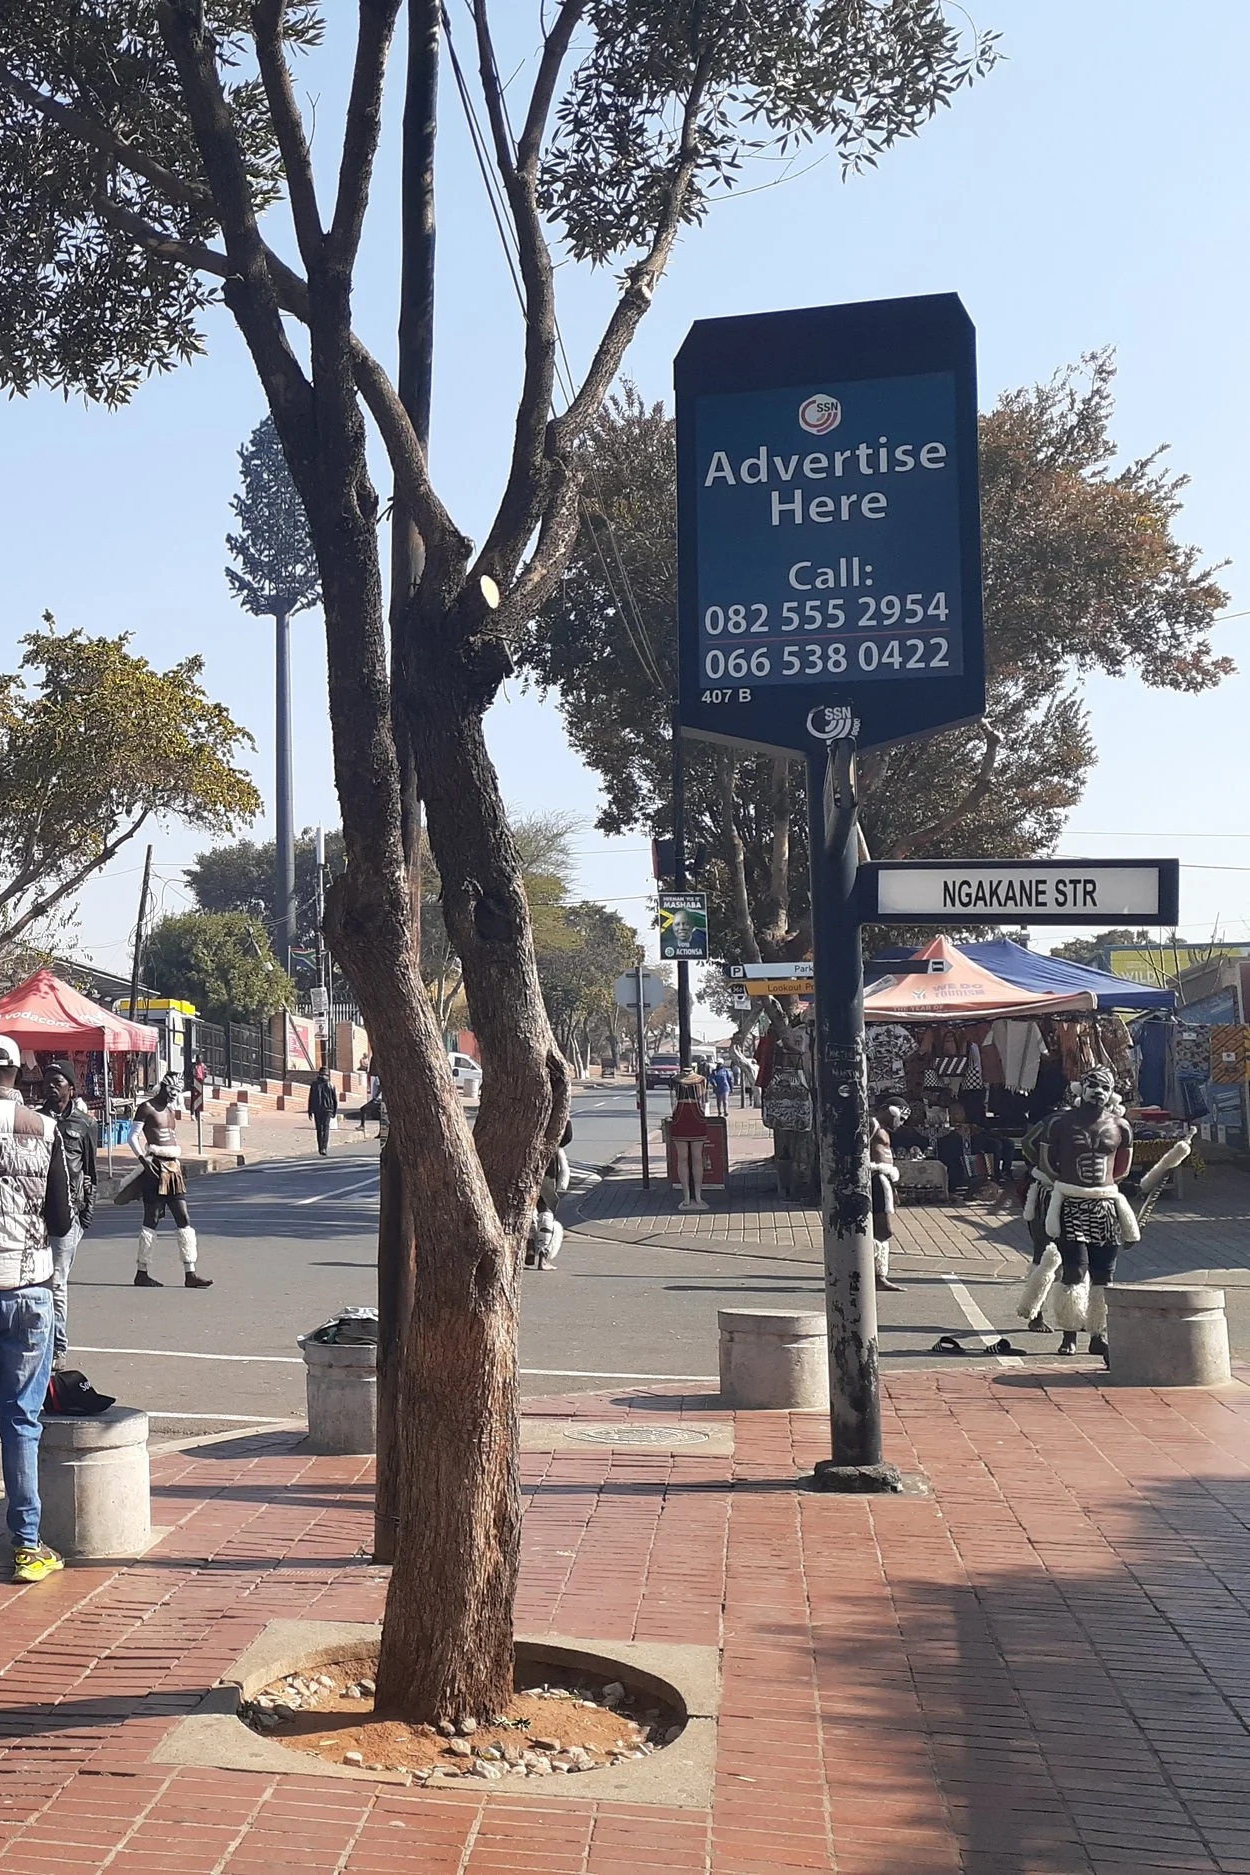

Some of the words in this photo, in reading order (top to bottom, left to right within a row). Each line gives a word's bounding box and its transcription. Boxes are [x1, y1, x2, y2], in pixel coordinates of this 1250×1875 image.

[816, 402, 838, 413] SSN
[704, 436, 947, 487] Advertise
[771, 489, 888, 526] Here
[788, 557, 874, 590] Call:
[705, 603, 769, 635] 082
[781, 599, 846, 631] 555
[858, 592, 949, 627] 2954
[705, 647, 771, 679] 066
[782, 643, 848, 676] 538
[858, 637, 950, 671] 0422
[701, 689, 732, 704] 407
[738, 688, 751, 703] B
[824, 706, 851, 720] SSN
[943, 879, 1048, 907] NGAKANE
[1054, 879, 1098, 907] STR
[733, 967, 741, 976] P
[767, 984, 801, 992] Lookout
[5, 1011, 70, 1028] vodacom
